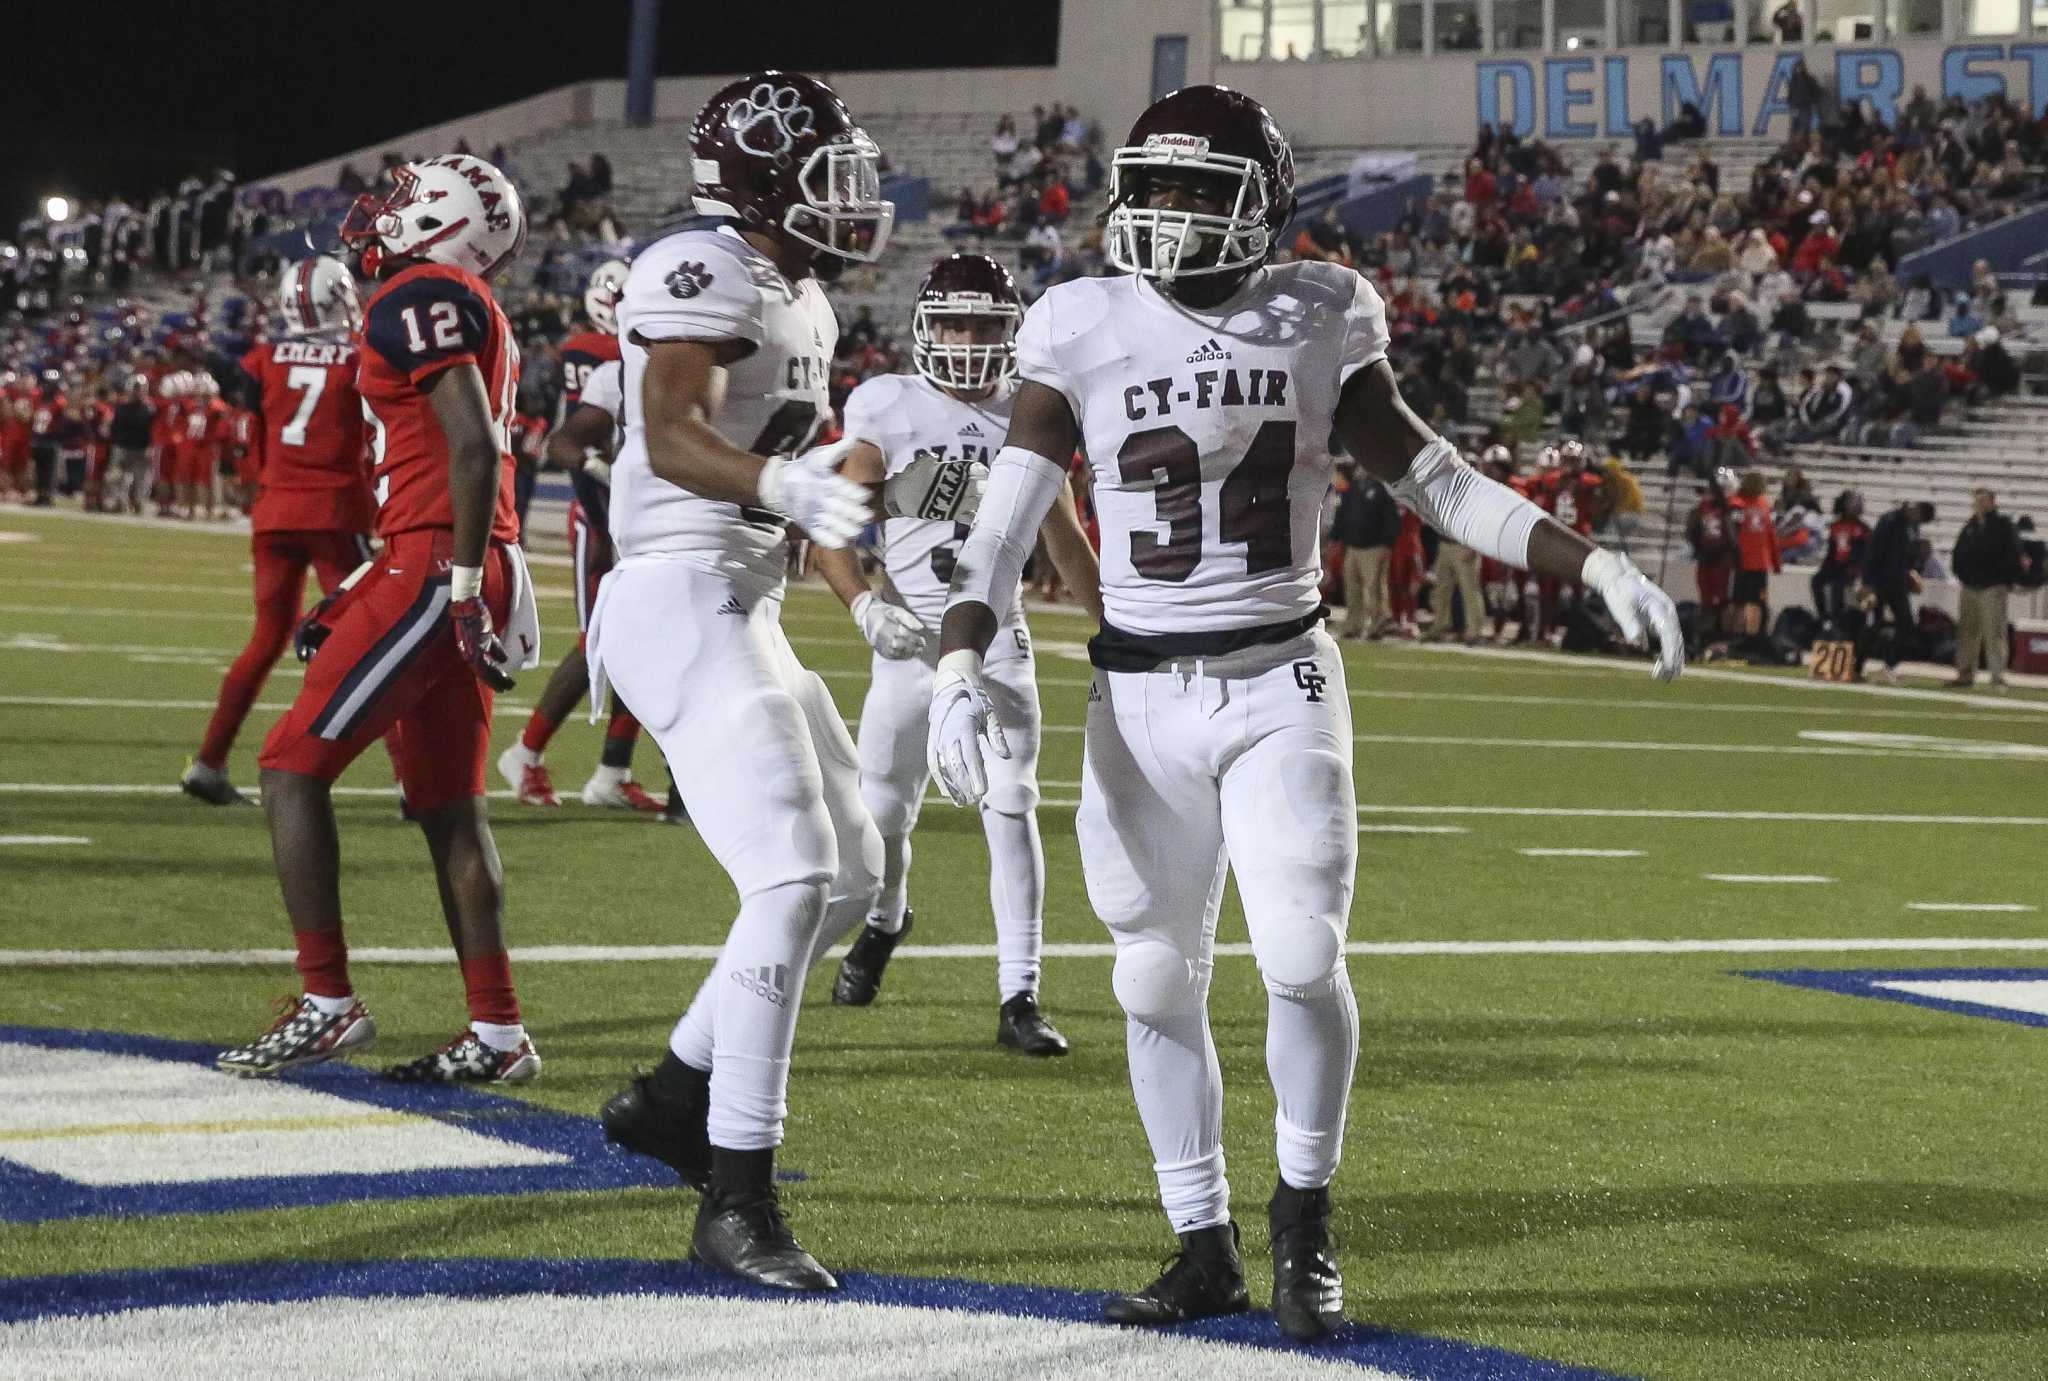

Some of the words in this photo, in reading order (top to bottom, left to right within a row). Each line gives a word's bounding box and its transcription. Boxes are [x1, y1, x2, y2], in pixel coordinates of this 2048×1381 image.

[1476, 49, 1904, 138] DELMAR
[1161, 136, 1196, 147] Riddell
[402, 301, 463, 352] 12
[1186, 351, 1232, 364] adidas
[281, 366, 328, 446] 7
[1123, 369, 1288, 421] CY-FAIR
[1117, 420, 1297, 582] 34
[1814, 643, 1848, 677] 20
